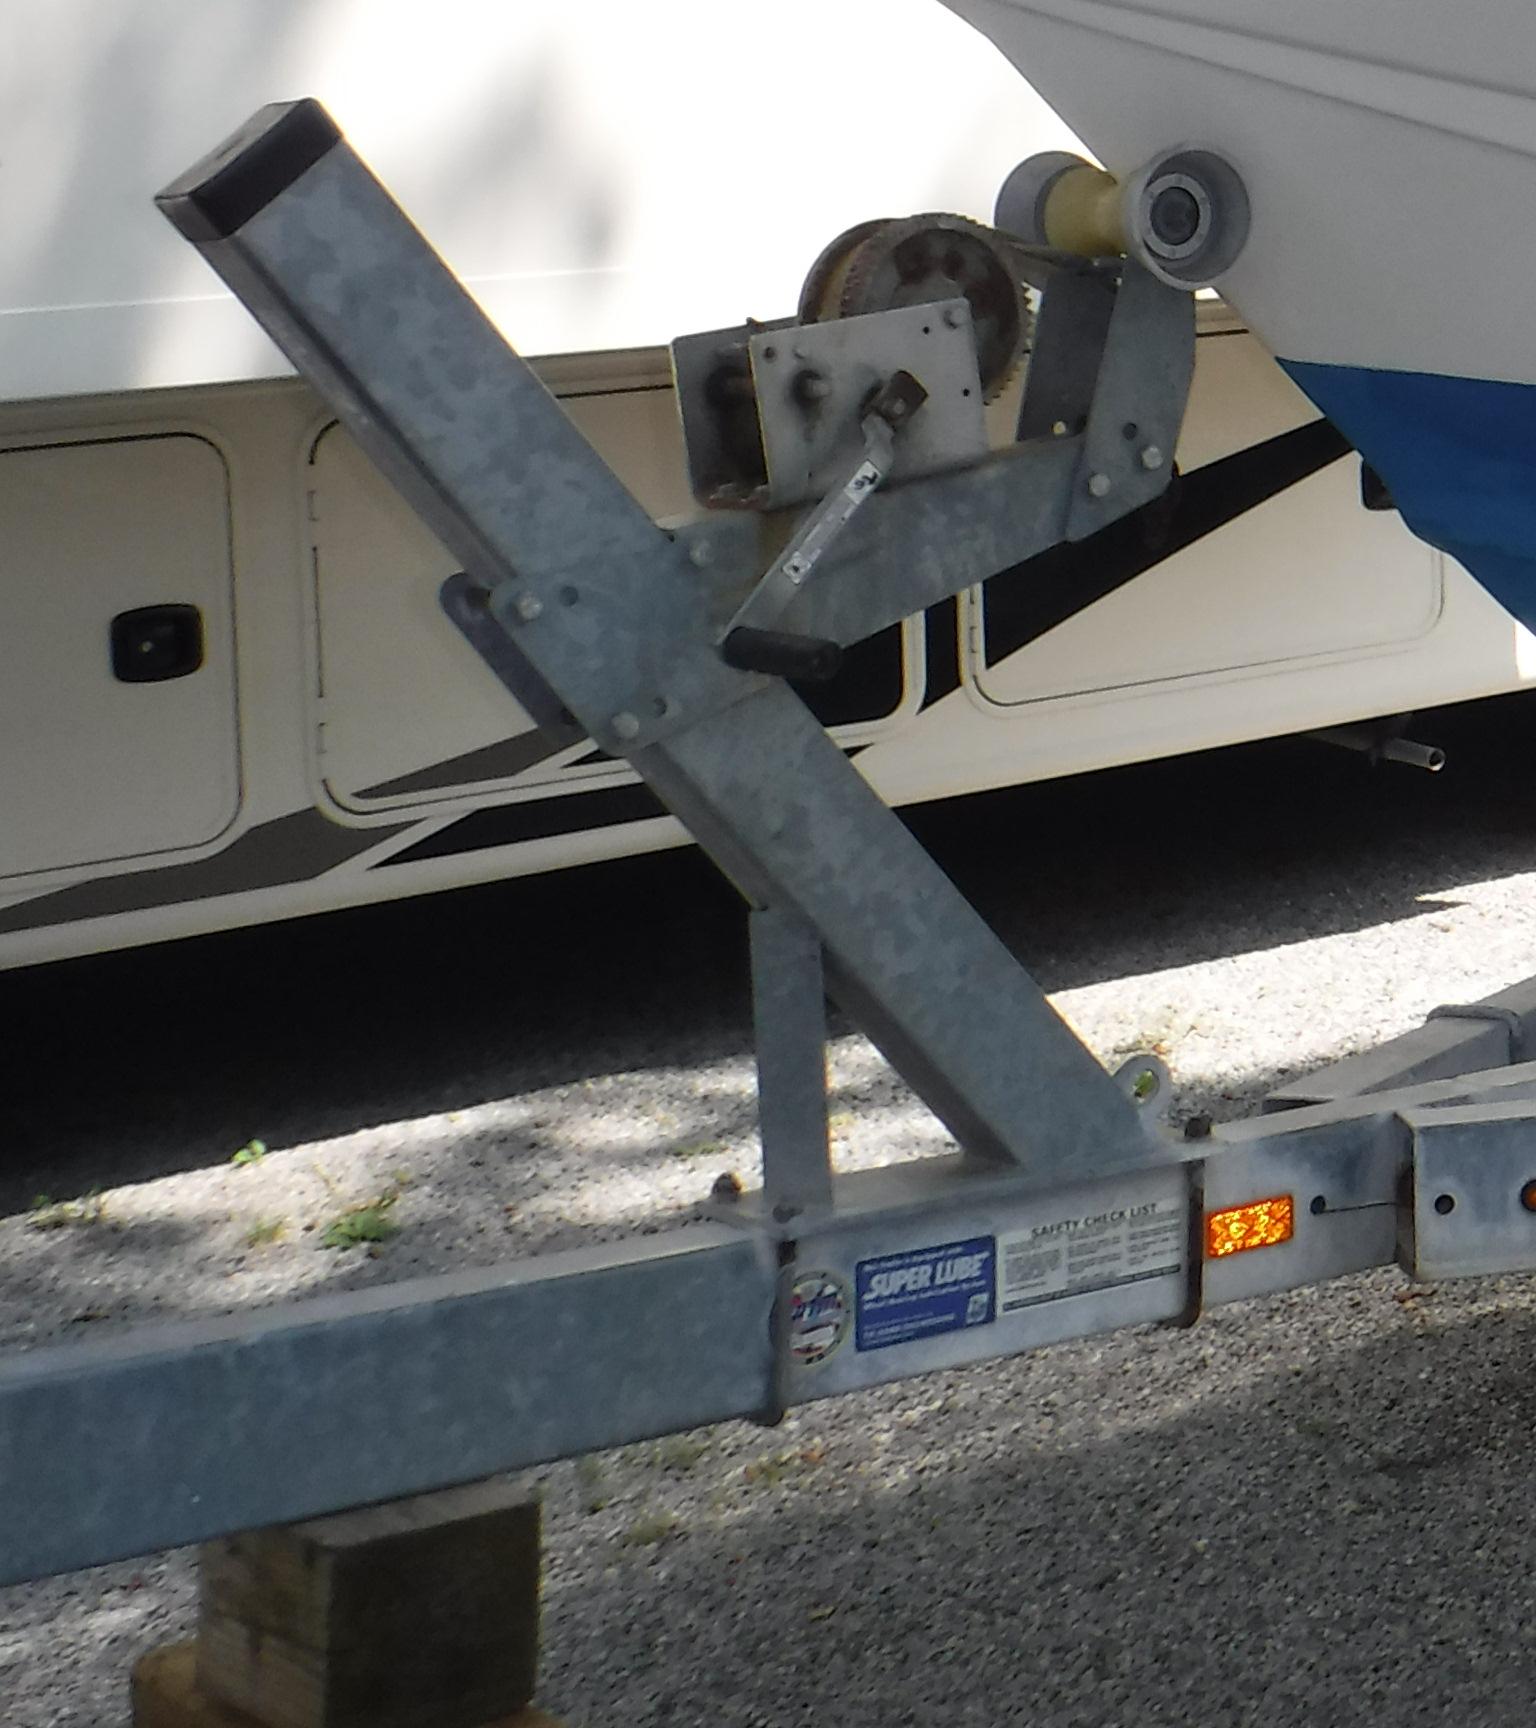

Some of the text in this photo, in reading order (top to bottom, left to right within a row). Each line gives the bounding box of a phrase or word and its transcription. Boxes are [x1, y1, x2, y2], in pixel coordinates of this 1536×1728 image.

[1031, 1203, 1157, 1238] SAFETY CHECK LIST
[862, 1265, 932, 1301] SUPER
[936, 1252, 989, 1285] LUBE
